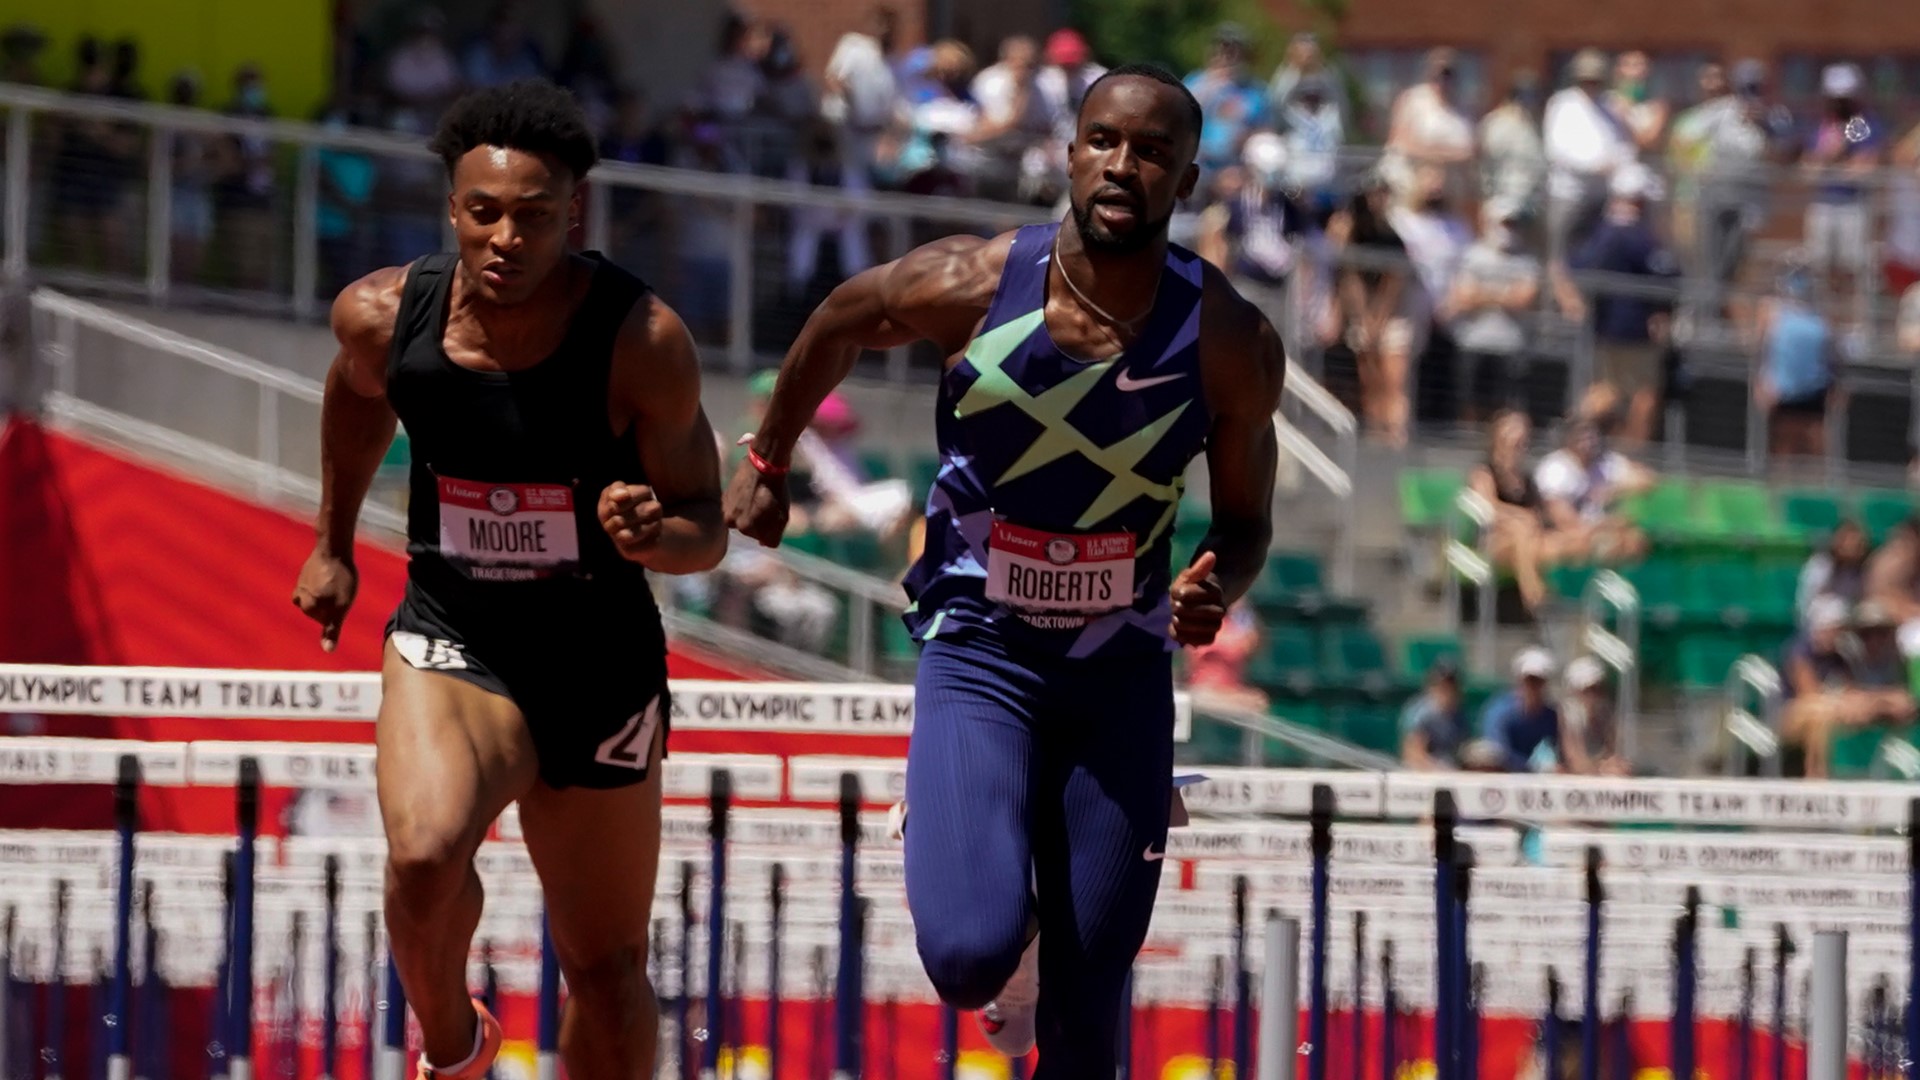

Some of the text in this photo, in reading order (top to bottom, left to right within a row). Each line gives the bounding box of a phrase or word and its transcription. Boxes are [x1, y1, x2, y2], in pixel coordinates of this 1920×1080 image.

[468, 517, 548, 553] MOORE
[1008, 562, 1112, 602] ROBERTS
[119, 679, 201, 706] TEAM
[221, 682, 323, 709] TRIALS
[698, 693, 815, 720] OLYMPIC
[833, 696, 912, 723] TEAM
